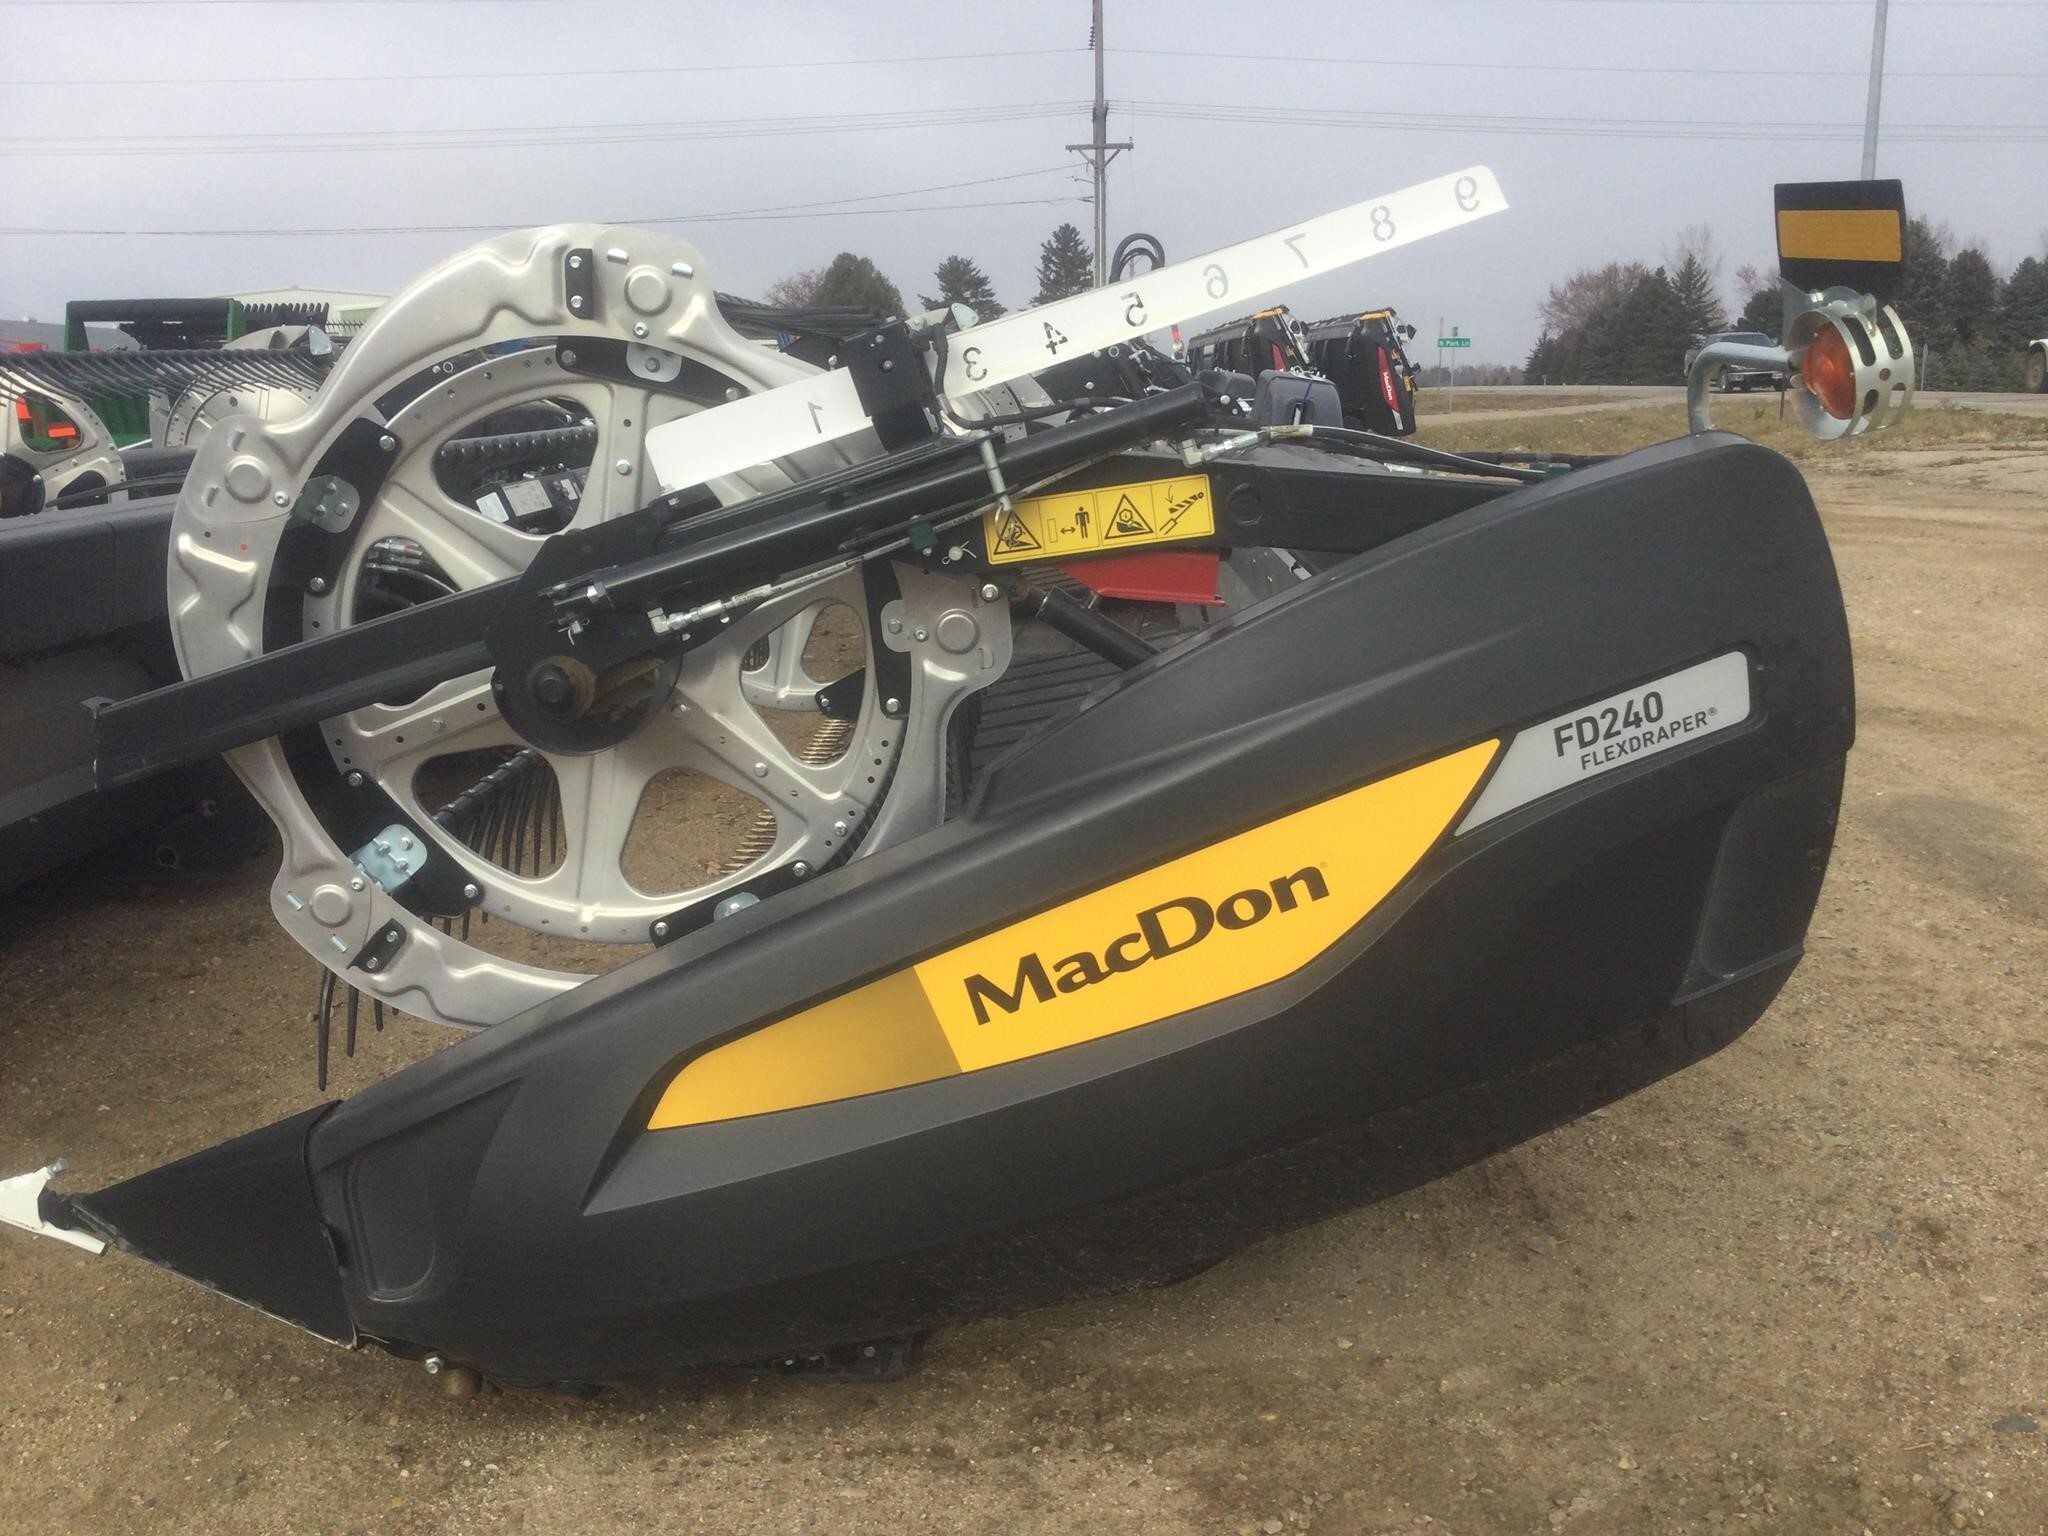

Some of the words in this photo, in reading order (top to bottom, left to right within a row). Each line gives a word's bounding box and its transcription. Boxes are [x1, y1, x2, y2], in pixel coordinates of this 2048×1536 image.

[1383, 371, 1393, 400] MacDon
[1553, 691, 1664, 757] FD240
[963, 865, 1330, 1026] MacDon
